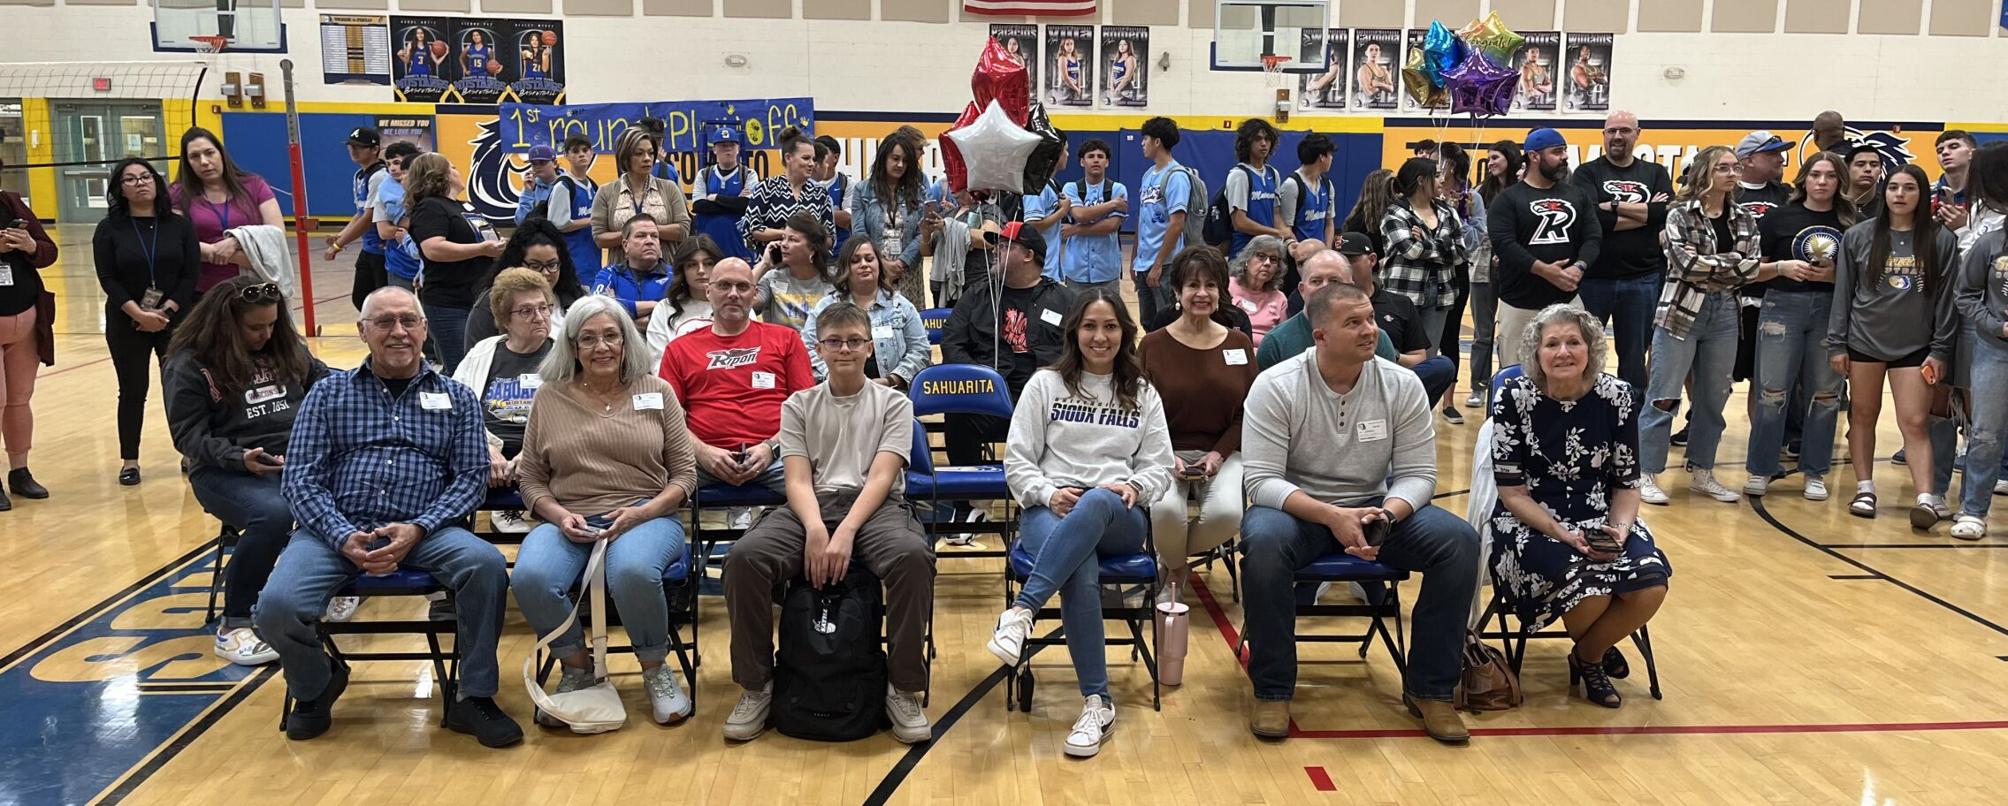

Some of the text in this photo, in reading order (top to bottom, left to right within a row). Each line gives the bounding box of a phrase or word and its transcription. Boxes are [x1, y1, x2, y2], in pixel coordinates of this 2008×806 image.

[473, 58, 482, 67] 15
[390, 119, 415, 127] MISSED
[417, 119, 429, 127] YOU
[923, 379, 994, 395] SAHUARITA
[1051, 402, 1140, 429] SIOUX FALLS
